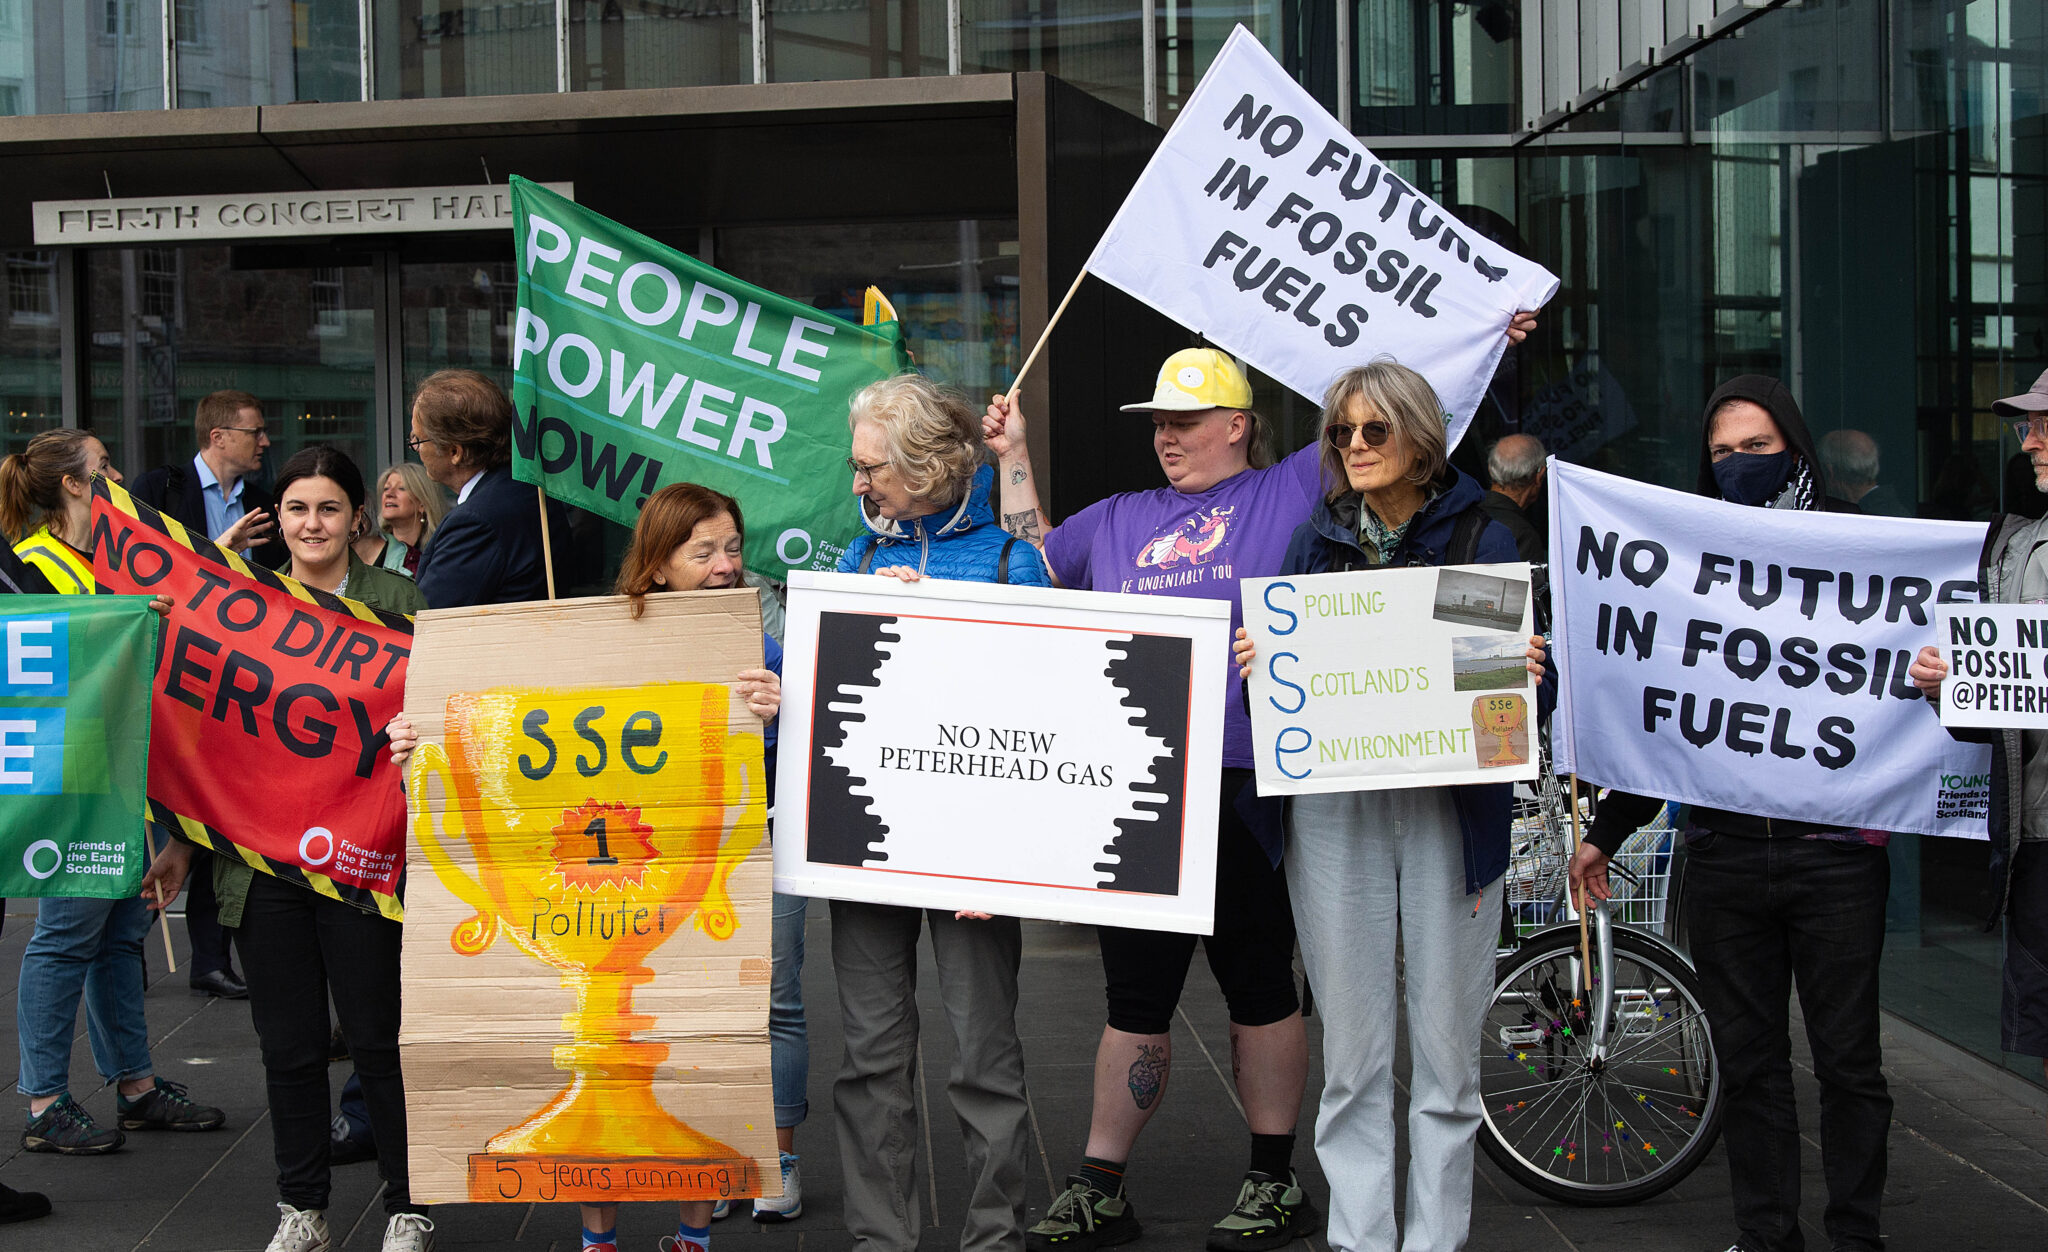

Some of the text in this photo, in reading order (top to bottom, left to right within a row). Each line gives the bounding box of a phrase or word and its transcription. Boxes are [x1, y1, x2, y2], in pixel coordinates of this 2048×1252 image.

[1223, 93, 1508, 283] NO FUTU
[58, 194, 512, 233] PERTH CONCERT HAL
[1204, 157, 1441, 318] IN FOSSIL
[526, 213, 836, 383] PEOPLE
[1203, 230, 1369, 348] FUELS
[513, 306, 787, 470] POWER
[512, 399, 663, 509] NOW!
[816, 551, 832, 563] the
[819, 540, 845, 556] Frien
[1576, 525, 1669, 588] NO
[1121, 565, 1232, 593] BE UNDENIABLY YOU
[93, 513, 411, 689] NO TO DIRT
[1949, 616, 2048, 649] NO NE
[1595, 602, 1924, 701] IN FOSSIL
[1951, 649, 2032, 680] FOSSIL
[153, 616, 391, 779] ERGY
[1952, 681, 2048, 714] @PETERH
[937, 724, 1057, 756] NO NEW
[1643, 686, 1857, 770] FUELS
[878, 746, 1114, 789] PETERHEAD GAS
[1937, 800, 1956, 809] the
[1938, 790, 1990, 799] Friends o
[1936, 809, 1988, 820] Scotland
[67, 852, 125, 864] the Earth
[68, 840, 126, 852] Friends of
[340, 839, 397, 862] Friends of
[582, 817, 619, 867] 1
[65, 863, 124, 876] Scotland
[335, 861, 391, 882] Scotland
[337, 851, 393, 871] the Earth
[531, 897, 678, 941] Polluter
[495, 1159, 523, 1199] 5
